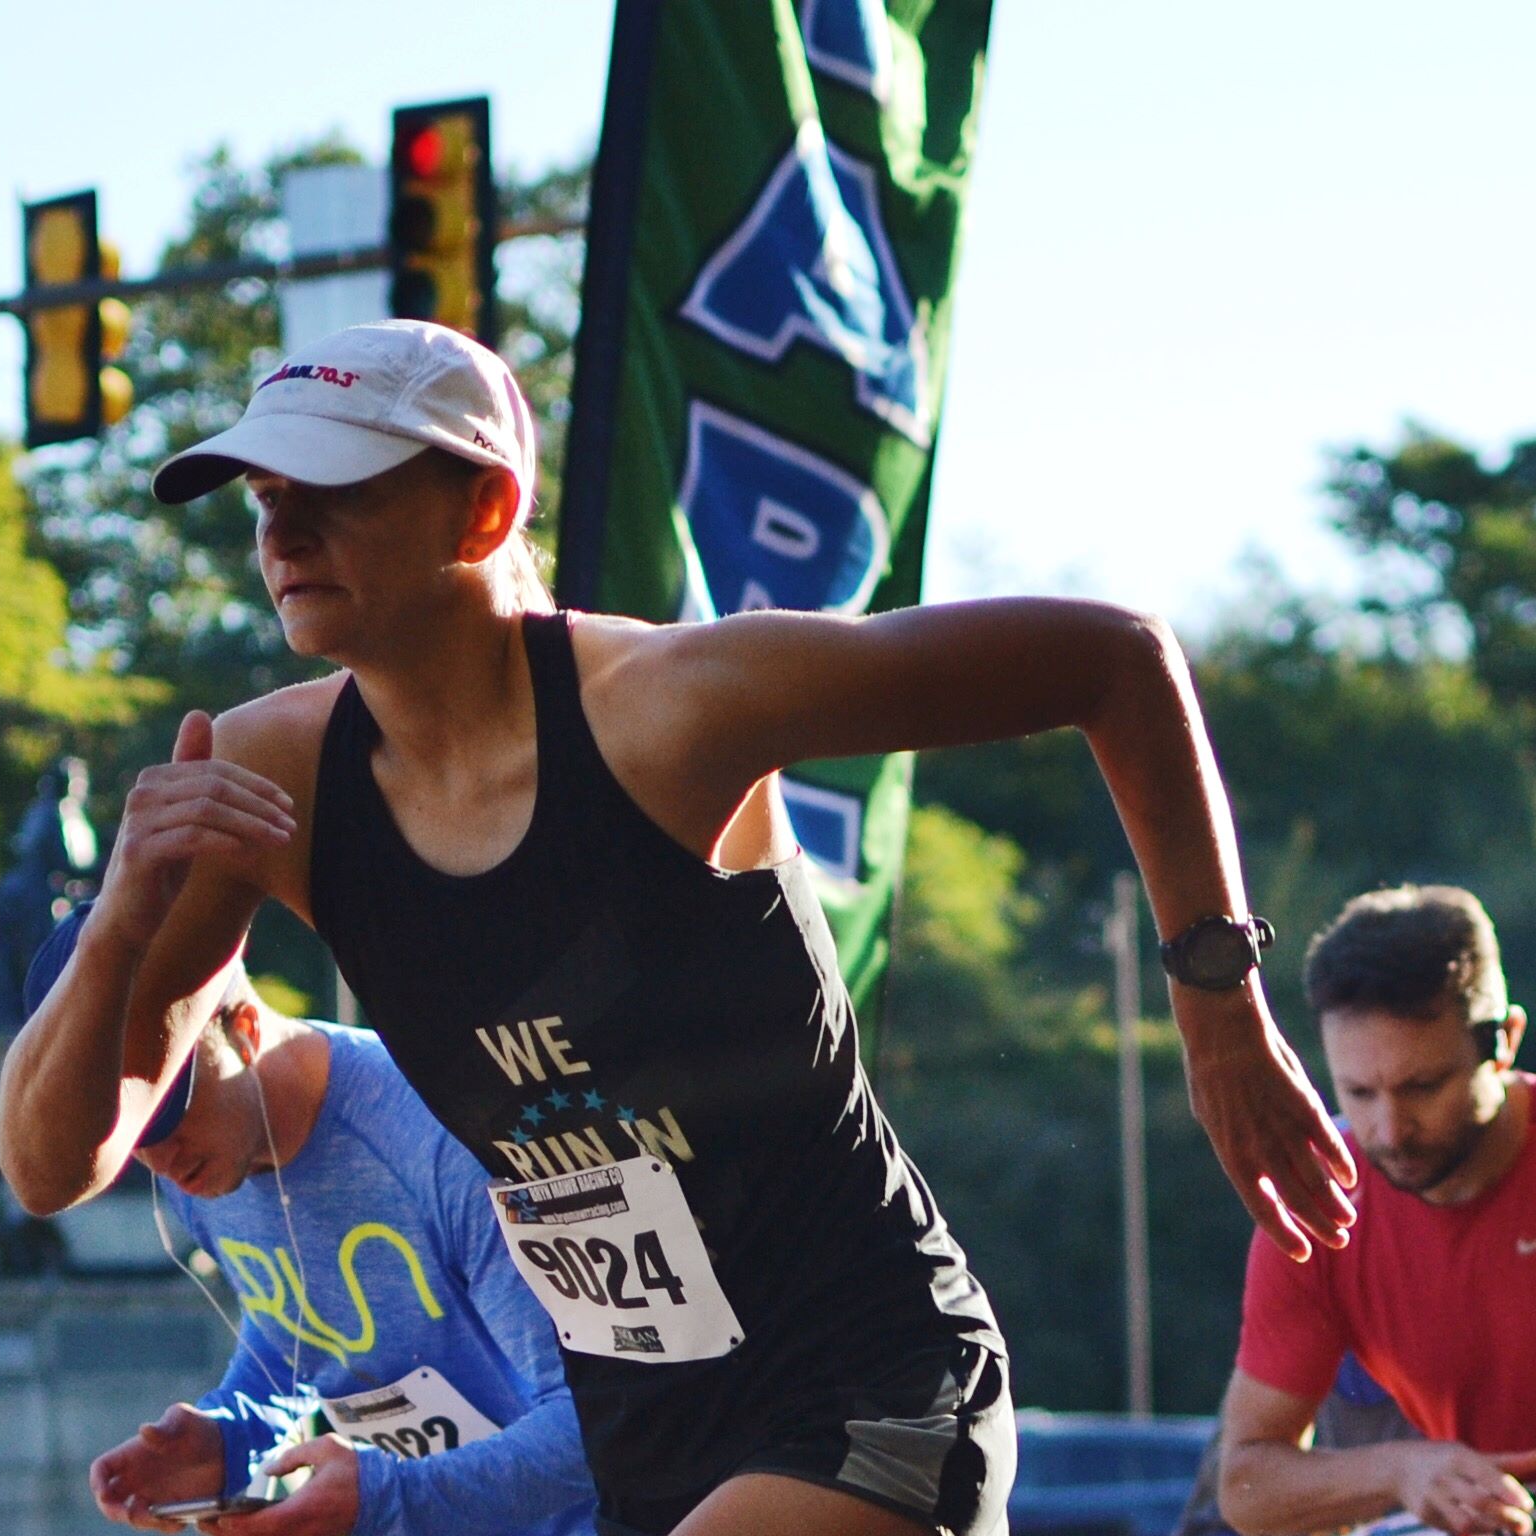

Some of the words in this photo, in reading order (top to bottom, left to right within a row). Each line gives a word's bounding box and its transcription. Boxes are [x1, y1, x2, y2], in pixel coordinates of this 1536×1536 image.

[475, 1015, 592, 1086] WE
[518, 1229, 687, 1309] 9024
[350, 1415, 460, 1461] 022
